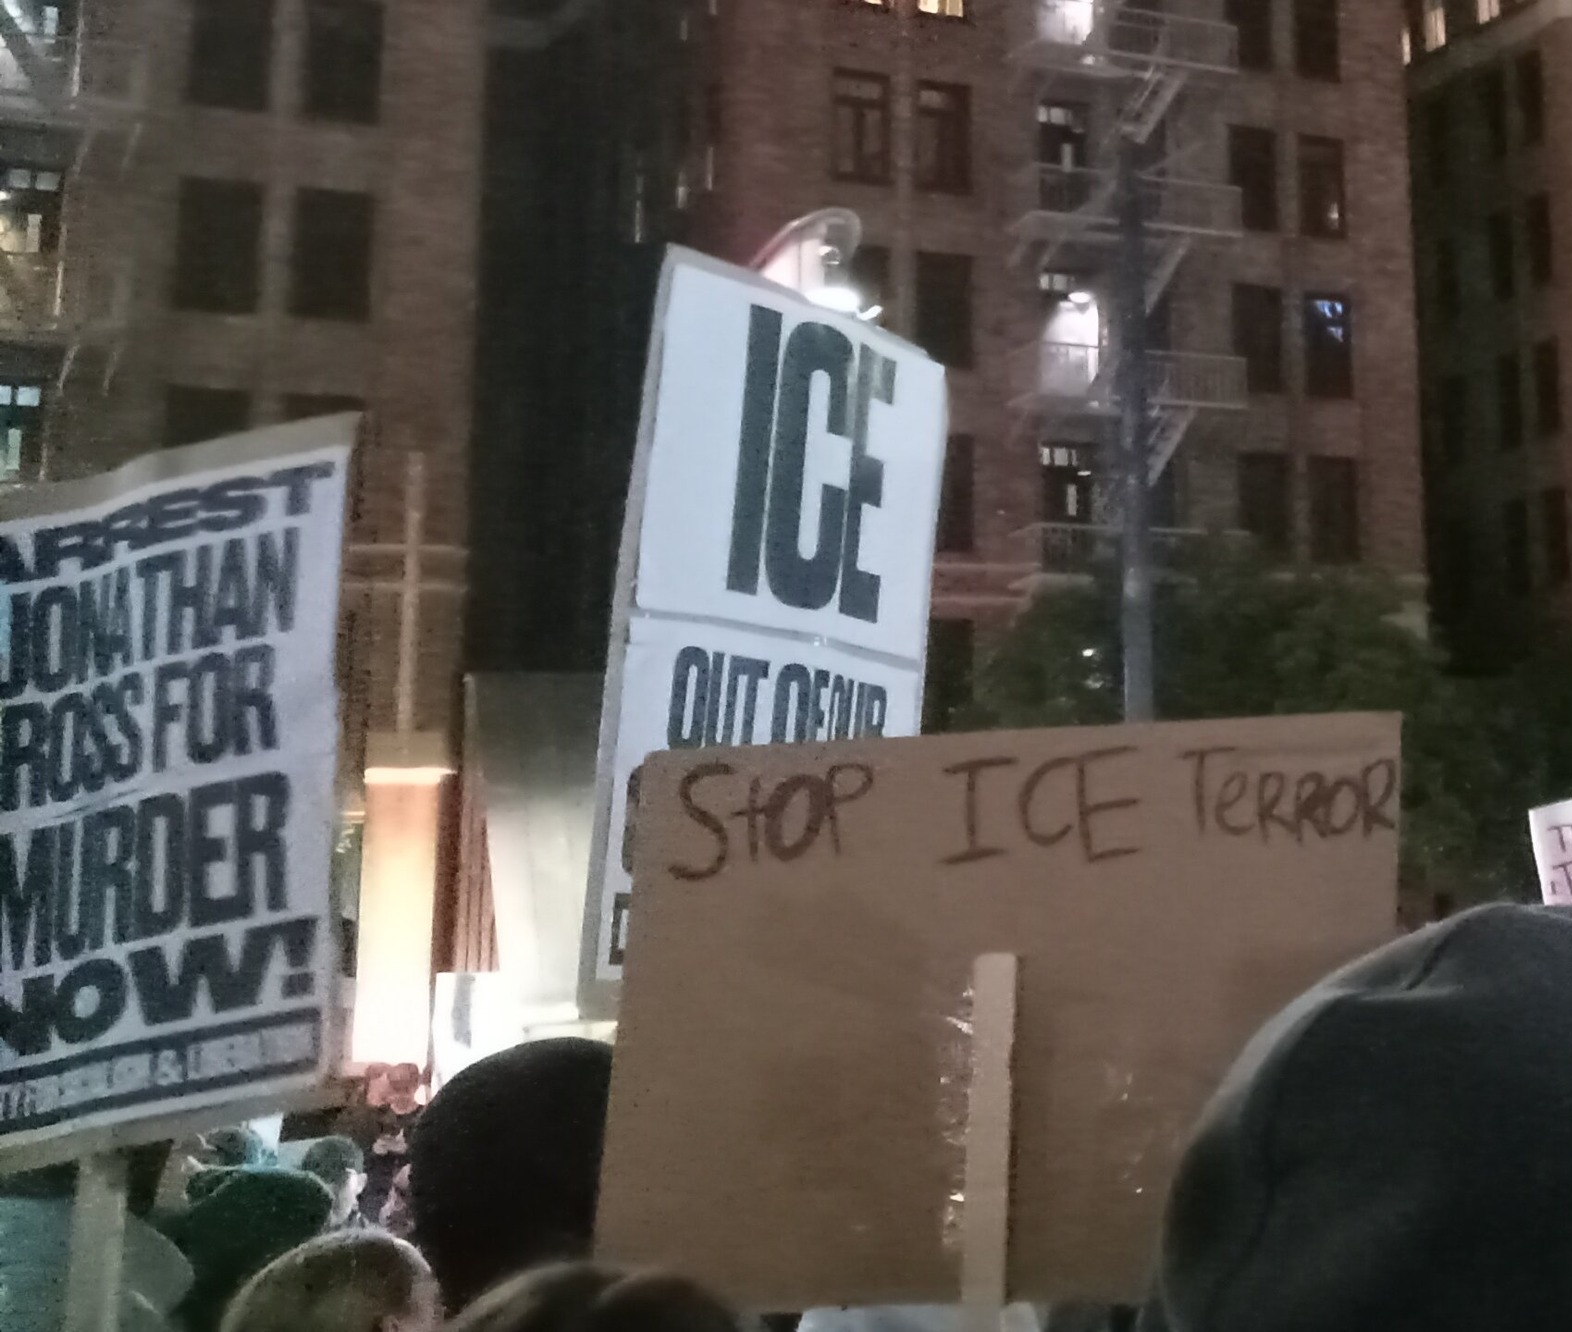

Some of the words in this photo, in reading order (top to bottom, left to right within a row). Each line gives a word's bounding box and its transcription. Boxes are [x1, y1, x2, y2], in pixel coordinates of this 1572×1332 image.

[726, 303, 897, 624] ICE
[0, 526, 299, 700] JONATHAN
[667, 645, 770, 748] OUT
[771, 663, 831, 745] OF
[0, 672, 144, 812] ROSS
[154, 643, 280, 773] FOR
[938, 744, 1140, 865] ICE
[0, 771, 291, 972] MURDER
